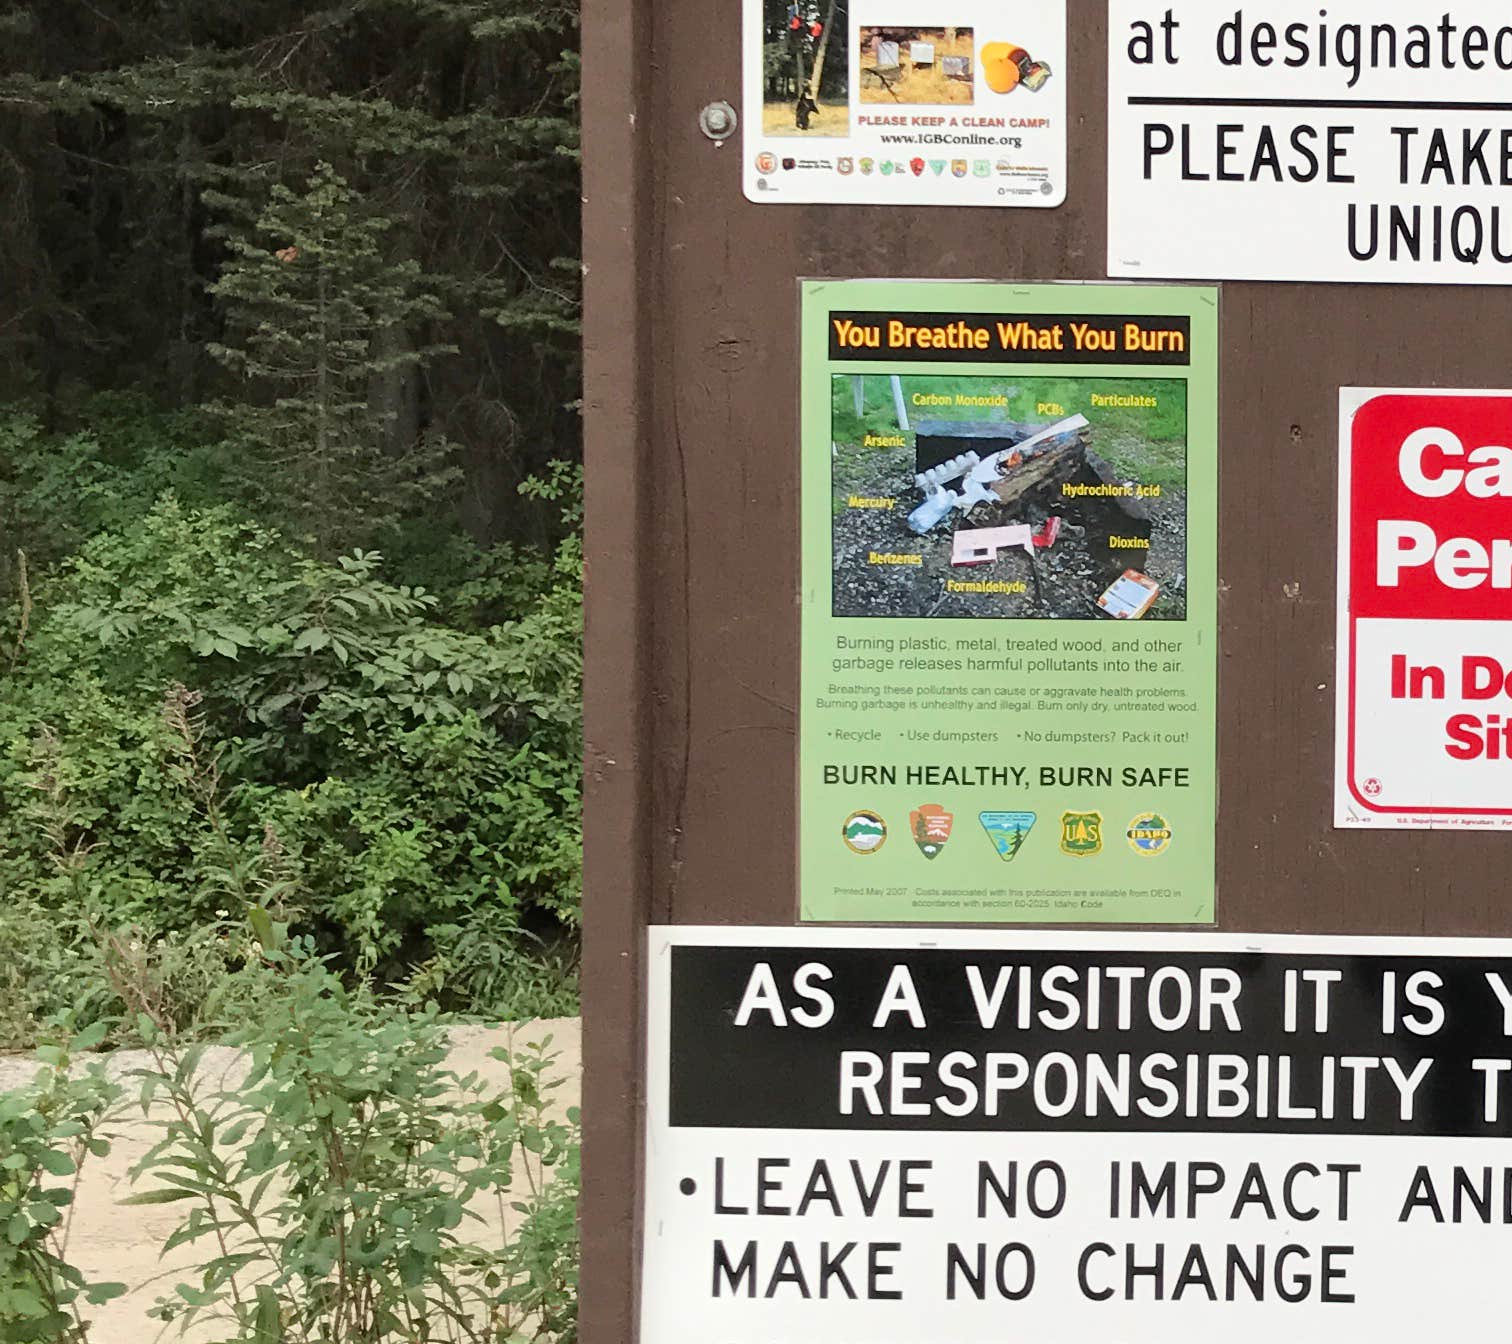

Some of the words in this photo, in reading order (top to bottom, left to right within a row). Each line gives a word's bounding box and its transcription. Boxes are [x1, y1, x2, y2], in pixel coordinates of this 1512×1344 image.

[1128, 9, 1179, 64] at
[858, 115, 906, 127] PLEASE
[910, 116, 945, 127] KEEP
[949, 117, 959, 127] A
[963, 117, 1005, 128] CLEAN
[1008, 118, 1050, 129] CAMP!
[881, 133, 1022, 148] www.IGBConline.org
[1144, 124, 1354, 183] PLEASE
[834, 320, 879, 348] You
[889, 321, 990, 349] Breathe
[997, 323, 1064, 350] What
[1070, 324, 1116, 351] You
[1124, 324, 1184, 351] Burn
[913, 393, 952, 406] Carbon
[956, 394, 1008, 407] Monoxide
[1091, 394, 1157, 407] Particulates
[864, 435, 905, 447] Arsenic
[1062, 484, 1132, 498] Hydrochloric
[1135, 484, 1160, 497] Acid
[848, 495, 895, 509] Mercury
[1109, 536, 1150, 550] Dioxins
[869, 552, 922, 564] Benzenes
[947, 581, 1026, 594] Formaldehyde
[836, 636, 894, 654] Burning
[1006, 638, 1057, 652] treated
[1112, 639, 1138, 652] and
[1144, 639, 1182, 653] other
[832, 658, 894, 675] garbage
[899, 657, 962, 671] releases
[967, 657, 1023, 671] harmful
[1028, 658, 1098, 676] pollutants
[1103, 659, 1130, 673] into
[1134, 659, 1158, 673] the
[1392, 655, 1444, 699] In
[835, 728, 881, 744] Recycle
[907, 729, 930, 742] Use
[933, 729, 998, 746] dumpsters
[823, 765, 897, 785] BURN
[906, 766, 1030, 790] HEALTHY,
[1040, 767, 1112, 786] BURN
[1121, 768, 1190, 788] SAFE
[735, 963, 834, 1027] AS
[873, 965, 926, 1027] A
[966, 966, 1241, 1031] VISITOR
[1285, 970, 1341, 1032] IT
[1383, 971, 1444, 1035] IS
[840, 1051, 1433, 1120] RESPONSIBILITY
[715, 1157, 933, 1218] LEAVE
[978, 1160, 1066, 1218] NO
[1110, 1161, 1361, 1221] IMPACT
[713, 1240, 902, 1300] MAKE
[947, 1242, 1035, 1300] NO
[1078, 1242, 1355, 1303] CHANGE
